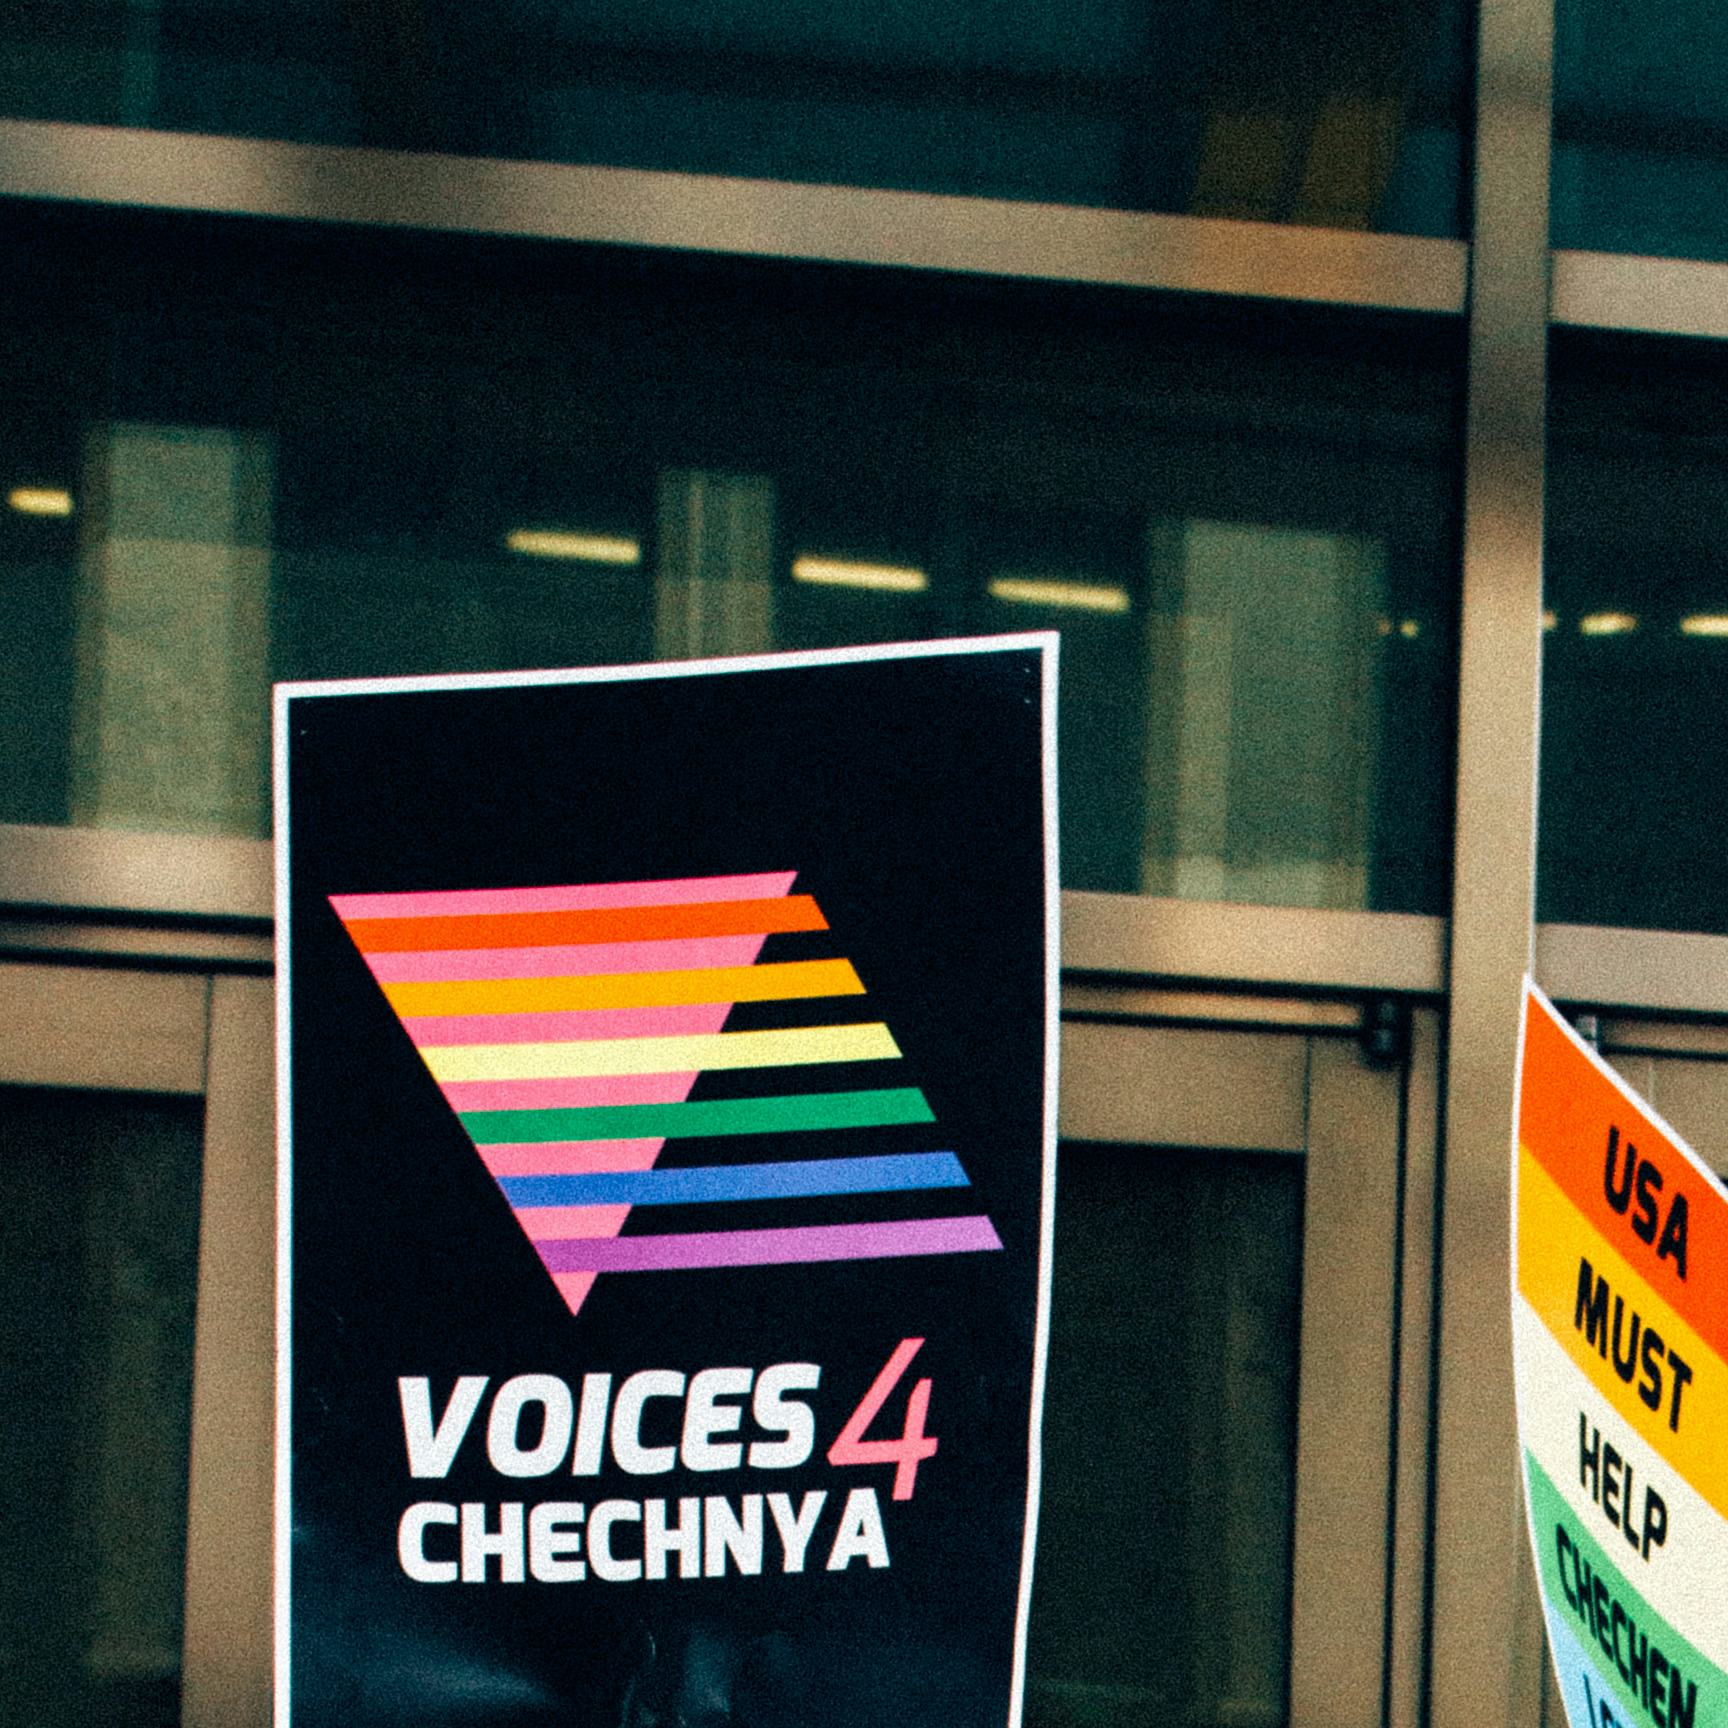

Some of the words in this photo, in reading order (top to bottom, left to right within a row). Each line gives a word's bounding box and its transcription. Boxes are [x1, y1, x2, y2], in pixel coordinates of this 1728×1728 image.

[1602, 1124, 1689, 1282] USA
[398, 1361, 822, 1480] VOICES
[826, 1336, 938, 1502] 4
[1574, 1257, 1693, 1433] MUST
[397, 1486, 890, 1584] CHECHNYA
[1578, 1410, 1668, 1562] HELP
